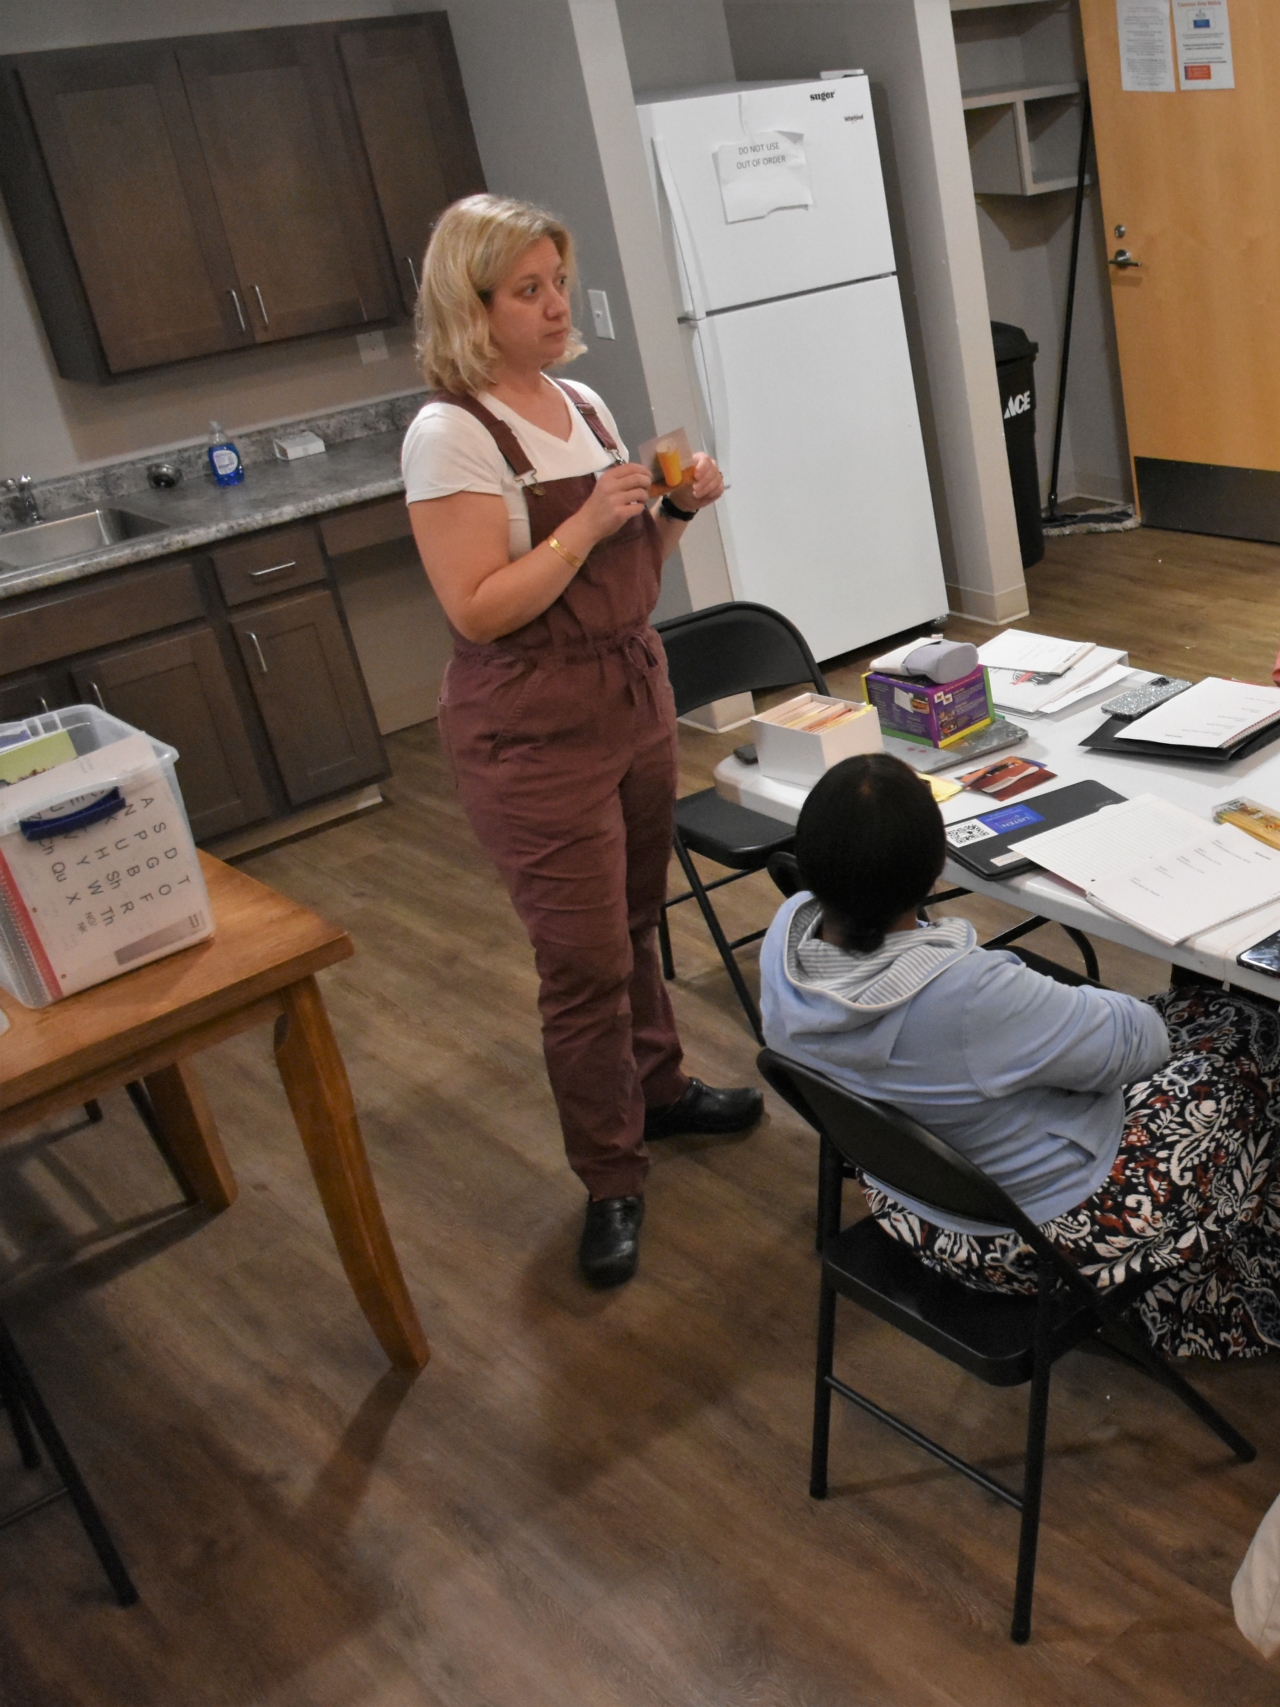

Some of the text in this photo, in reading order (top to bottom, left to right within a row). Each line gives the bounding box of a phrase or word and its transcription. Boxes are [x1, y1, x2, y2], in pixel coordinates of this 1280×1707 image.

[736, 155, 786, 170] OUT OF ORDER
[738, 141, 779, 155] DO NOT USE
[1003, 390, 1031, 419] ACE
[115, 838, 130, 850] U
[126, 865, 141, 877] B
[139, 893, 154, 902] F
[133, 830, 148, 840] P
[146, 856, 160, 869] G
[158, 884, 172, 896] O
[141, 797, 191, 885] A S D T
[51, 861, 68, 883] Qu
[65, 892, 82, 906] X
[76, 855, 91, 866] Y
[87, 879, 104, 896] W
[100, 905, 116, 926] Th
[94, 846, 110, 860] H
[106, 870, 122, 890] Sh
[120, 901, 135, 915] R
